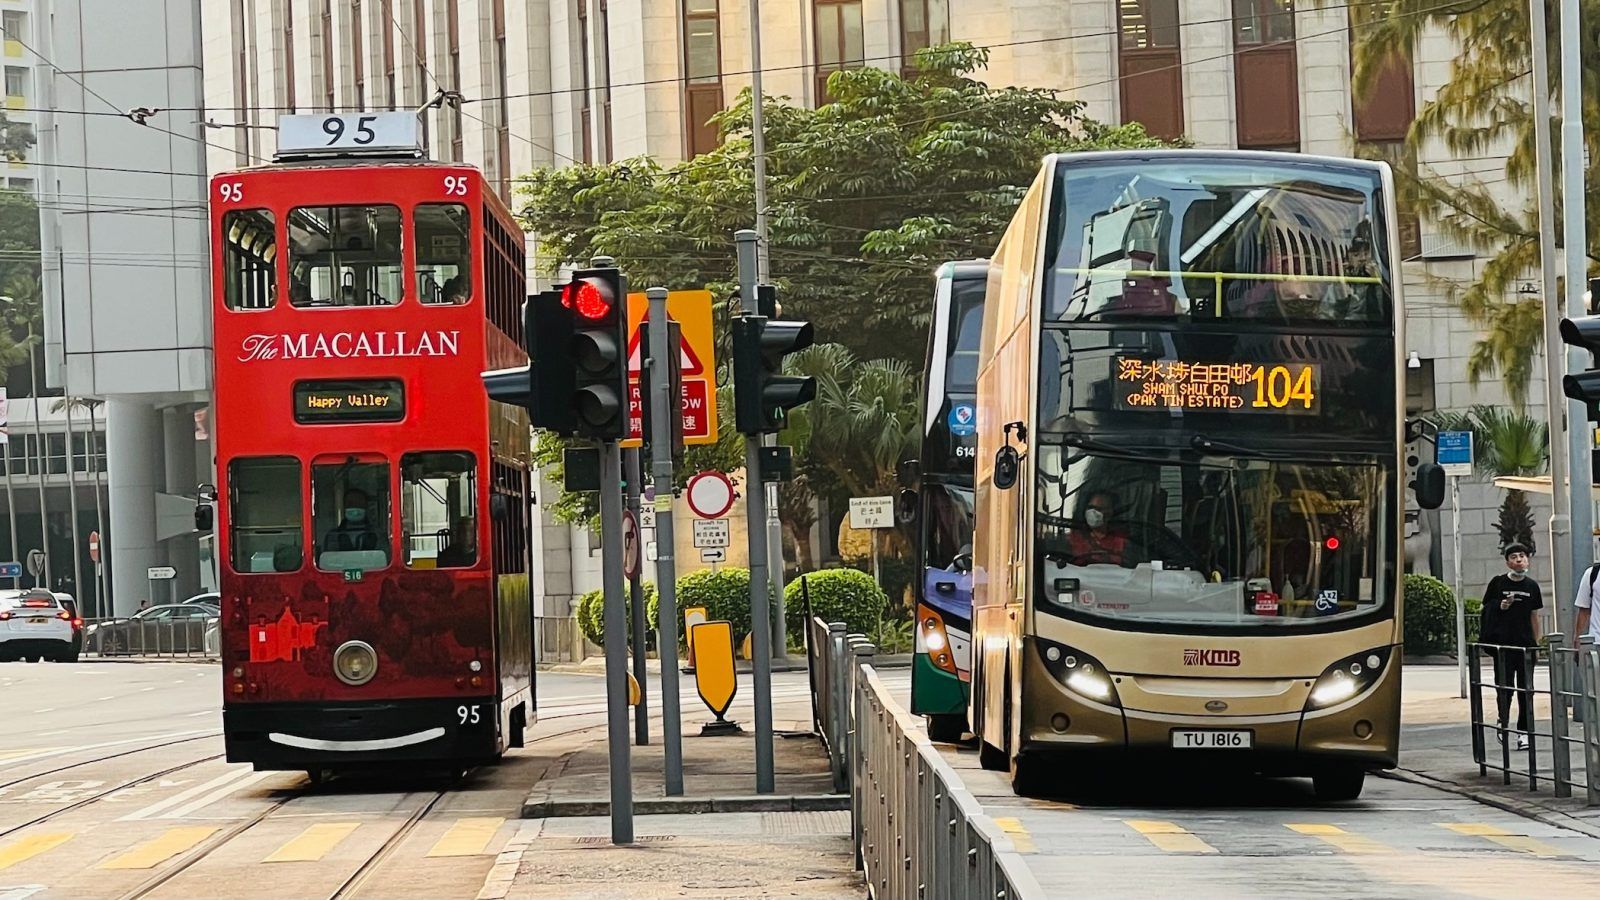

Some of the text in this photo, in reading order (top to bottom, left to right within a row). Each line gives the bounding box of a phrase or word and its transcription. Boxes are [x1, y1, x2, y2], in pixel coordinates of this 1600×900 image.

[322, 116, 377, 146] 95
[219, 182, 243, 203] 95
[444, 176, 468, 196] 95
[237, 331, 460, 363] The MACALLAN
[1142, 382, 1229, 396] SHAM SHUI PO
[1251, 365, 1315, 409] 104
[308, 394, 389, 409] Happy Valley
[1162, 394, 1184, 407] TIN
[457, 705, 480, 725] 95
[1183, 732, 1242, 746] TU 1816
